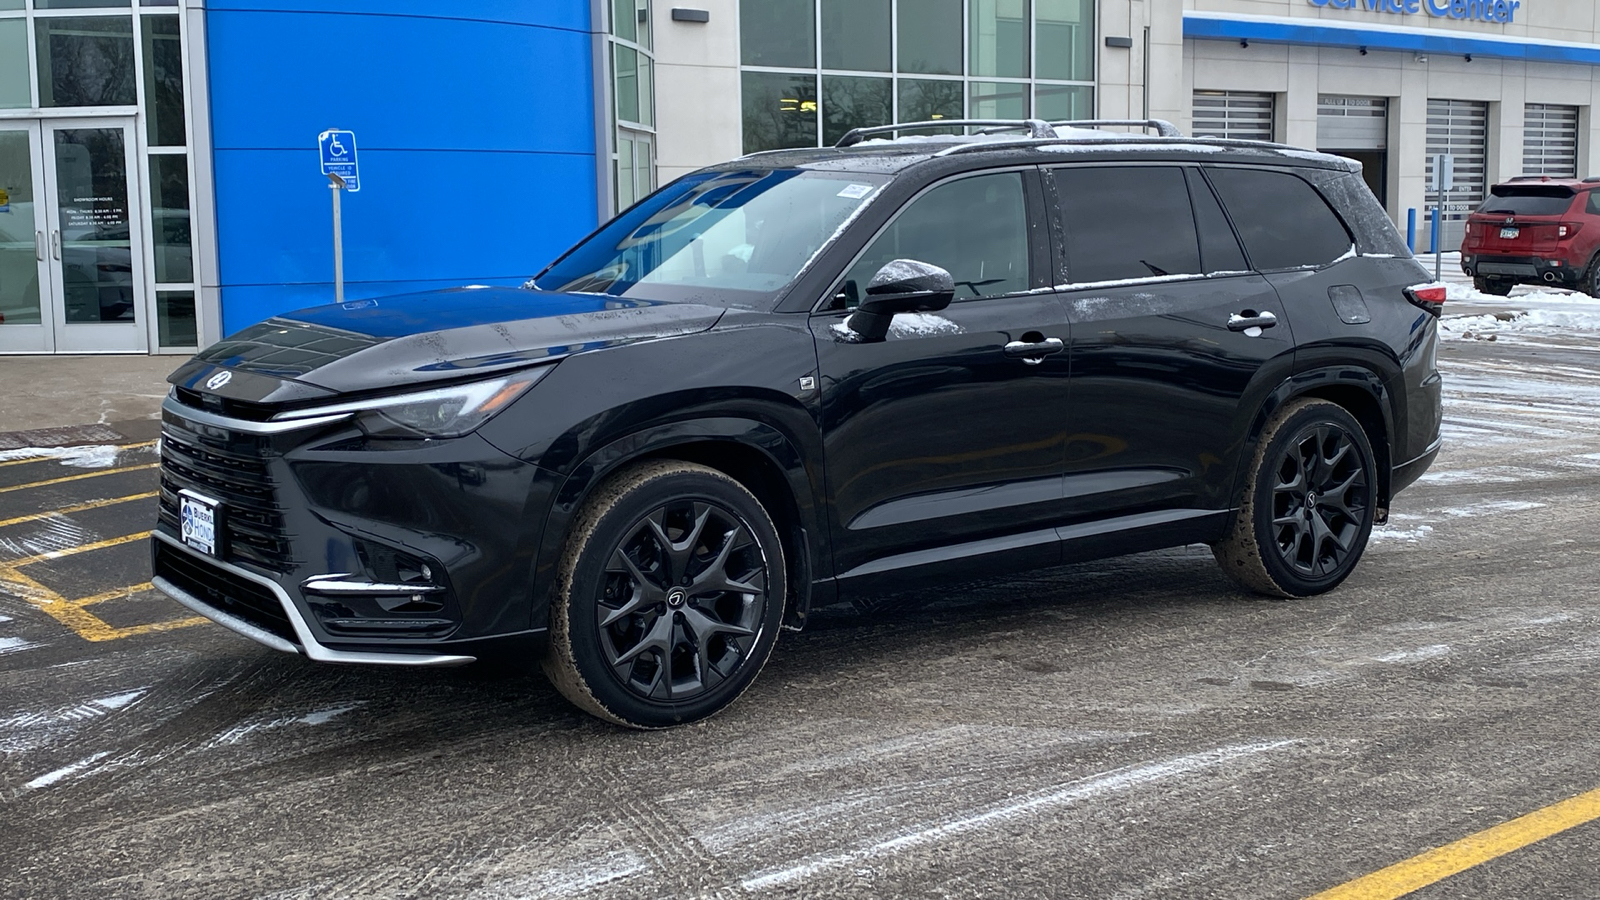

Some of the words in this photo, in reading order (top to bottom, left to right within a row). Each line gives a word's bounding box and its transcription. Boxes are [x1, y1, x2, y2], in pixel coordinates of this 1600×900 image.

[1308, 0, 1420, 14] vice
[1426, 0, 1520, 23] Center
[194, 506, 213, 524] BUERKL
